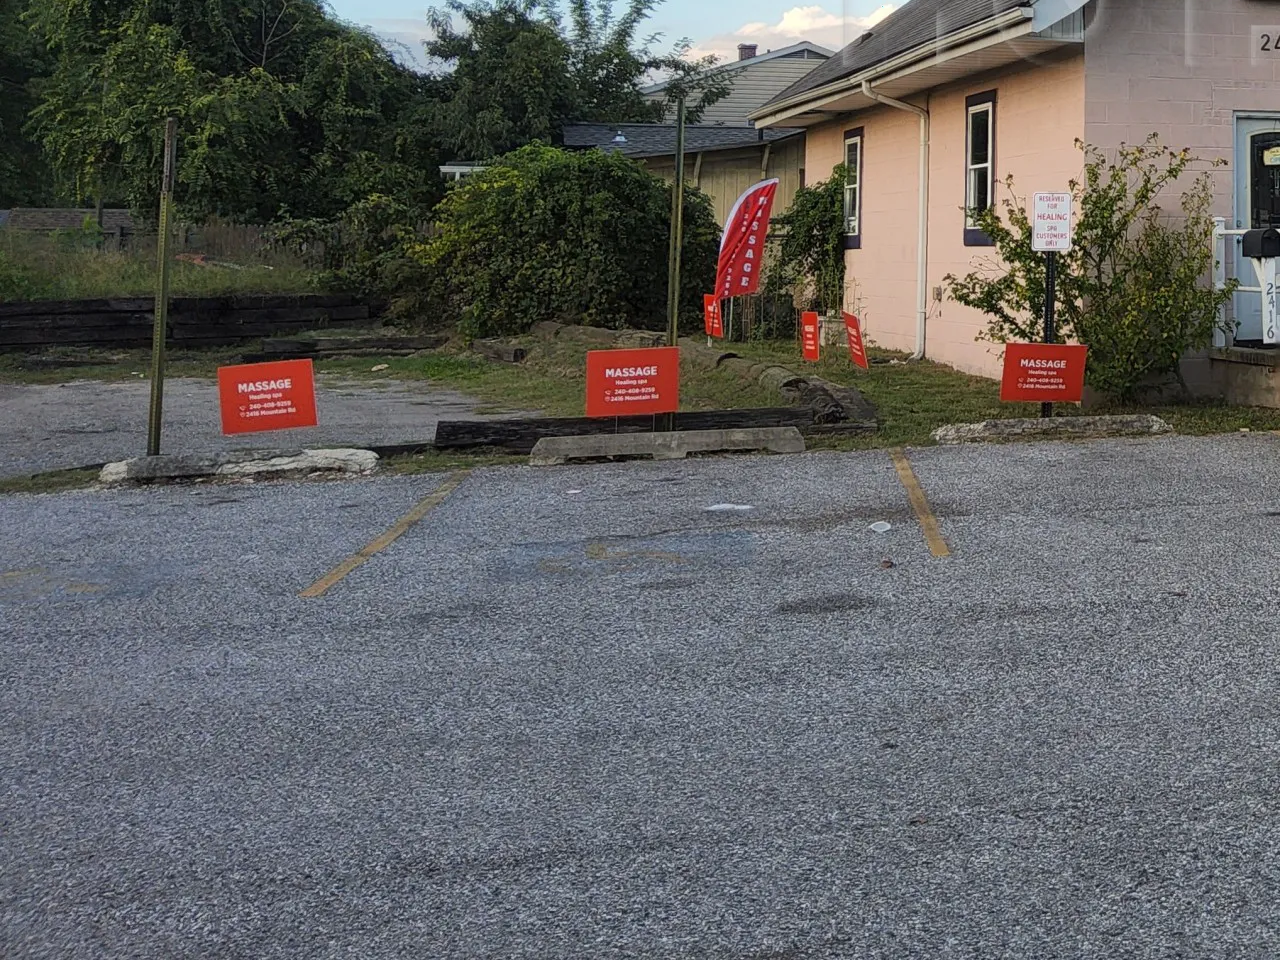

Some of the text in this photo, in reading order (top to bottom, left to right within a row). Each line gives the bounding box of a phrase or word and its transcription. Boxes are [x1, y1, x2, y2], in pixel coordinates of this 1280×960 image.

[1037, 213, 1068, 221] HEALING
[741, 196, 768, 287] MASSAGE
[1266, 282, 1275, 339] 2416
[1020, 359, 1067, 369] MASSAGE
[605, 366, 658, 378] MASSAGE
[237, 378, 292, 394] MASSAGE
